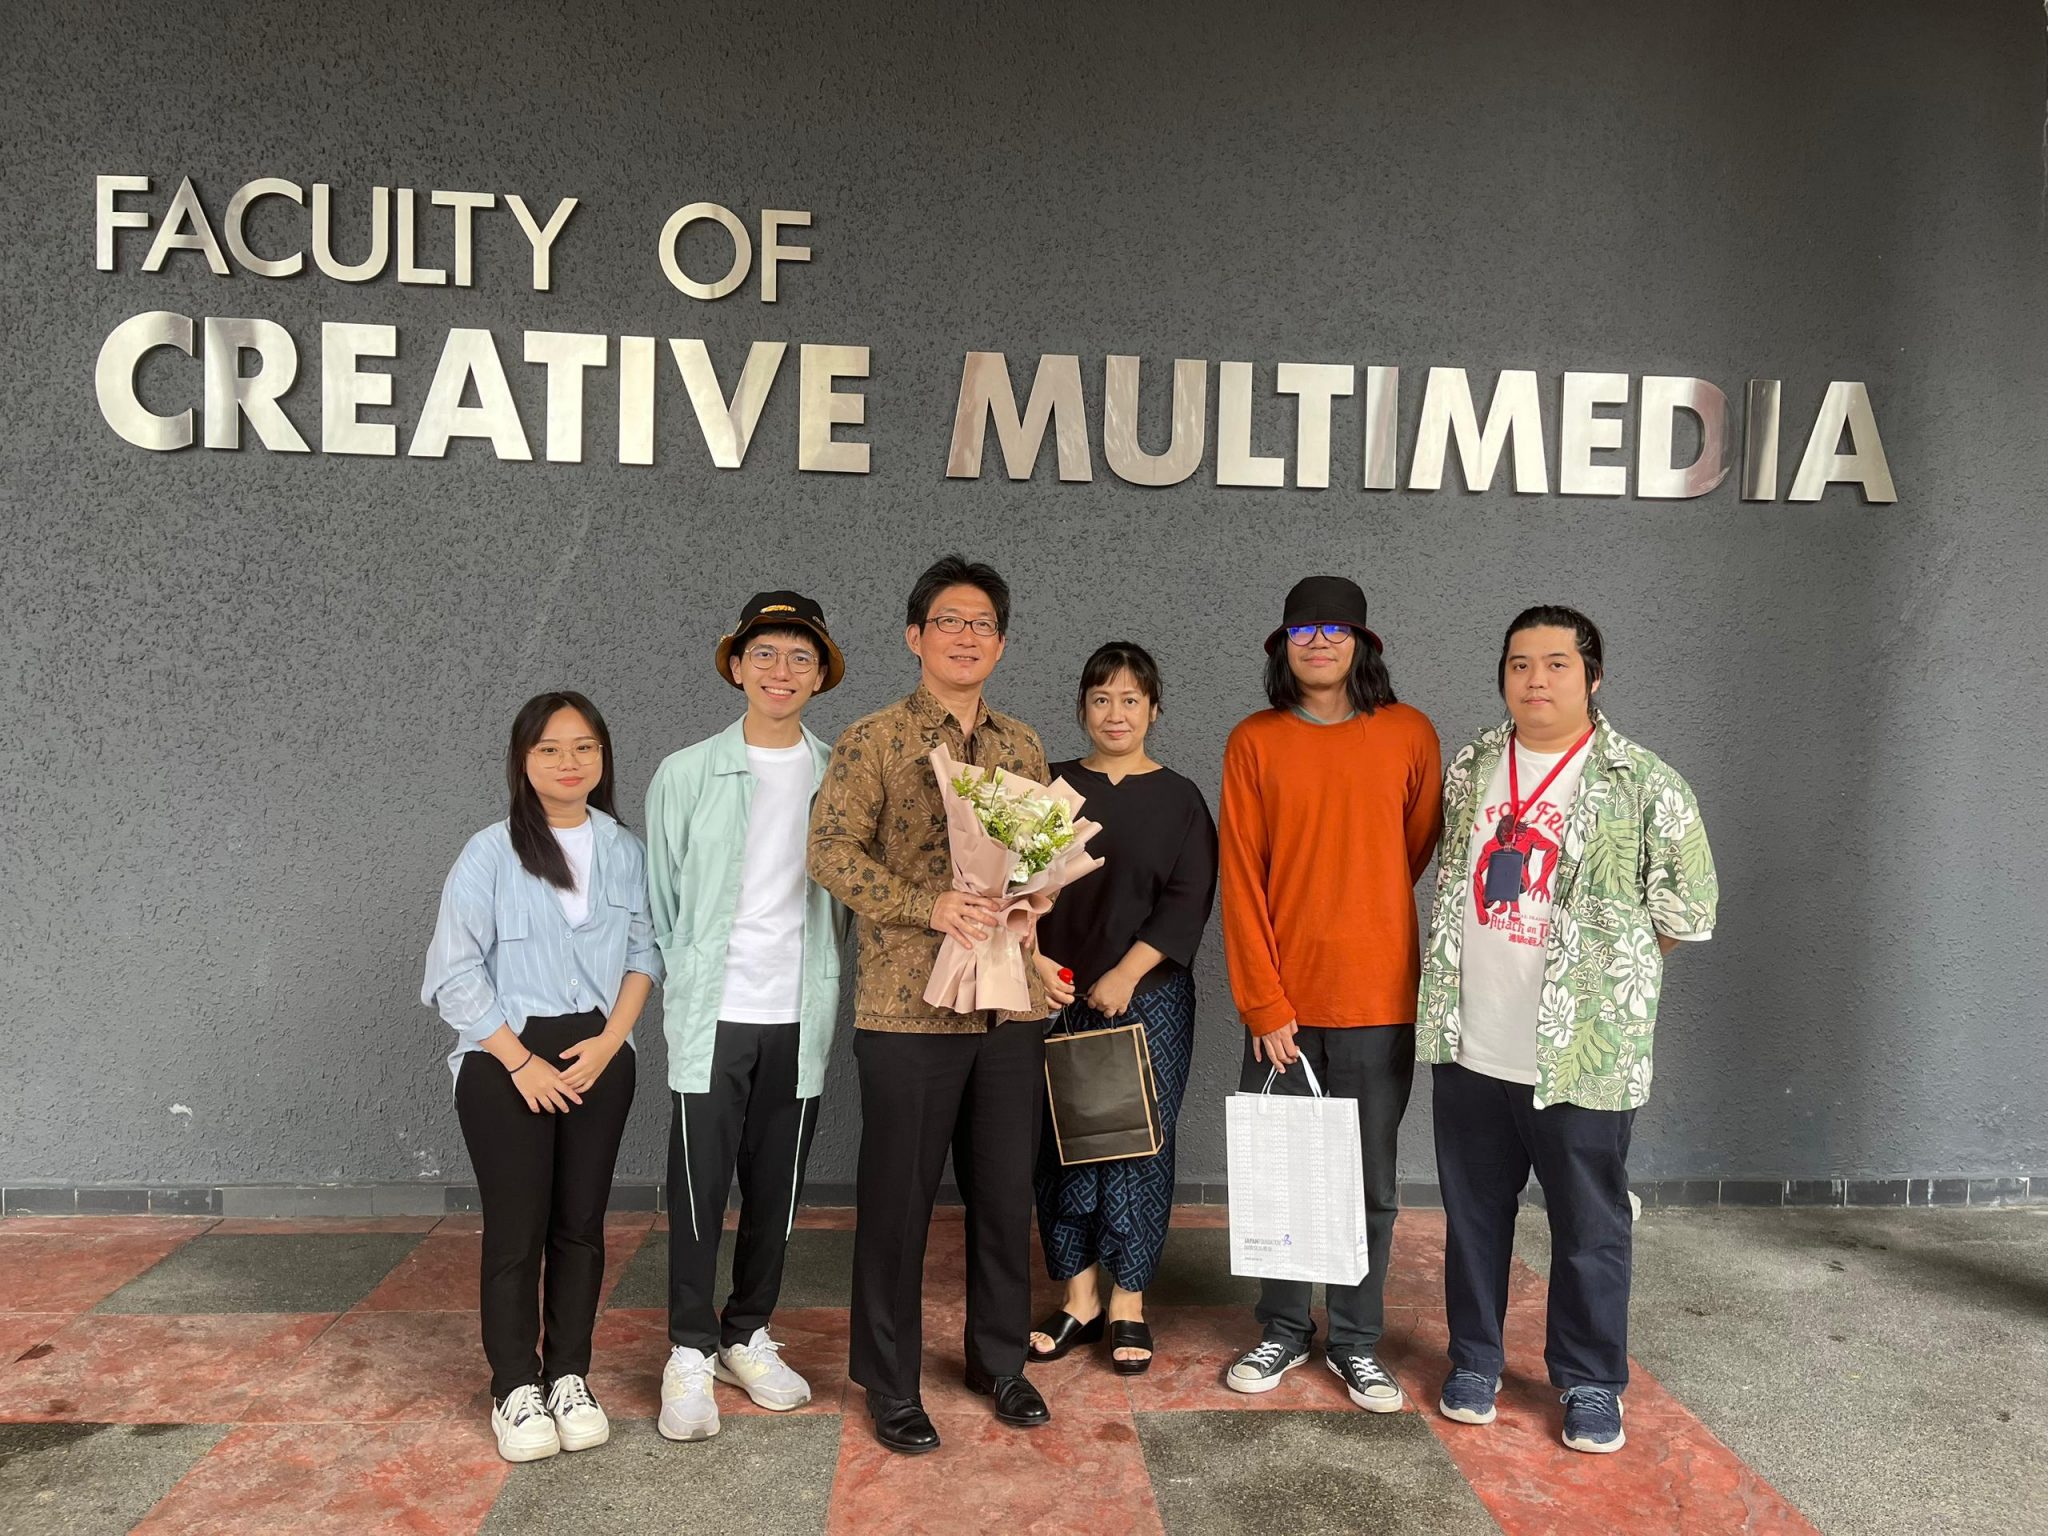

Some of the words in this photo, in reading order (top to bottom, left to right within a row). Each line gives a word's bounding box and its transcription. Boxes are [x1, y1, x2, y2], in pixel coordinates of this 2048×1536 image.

[96, 174, 579, 291] FACULTY
[657, 201, 812, 302] OF
[94, 310, 870, 474] CREATIVE
[945, 351, 1897, 504] MULTIMEDIA
[1489, 914, 1525, 934] Attack
